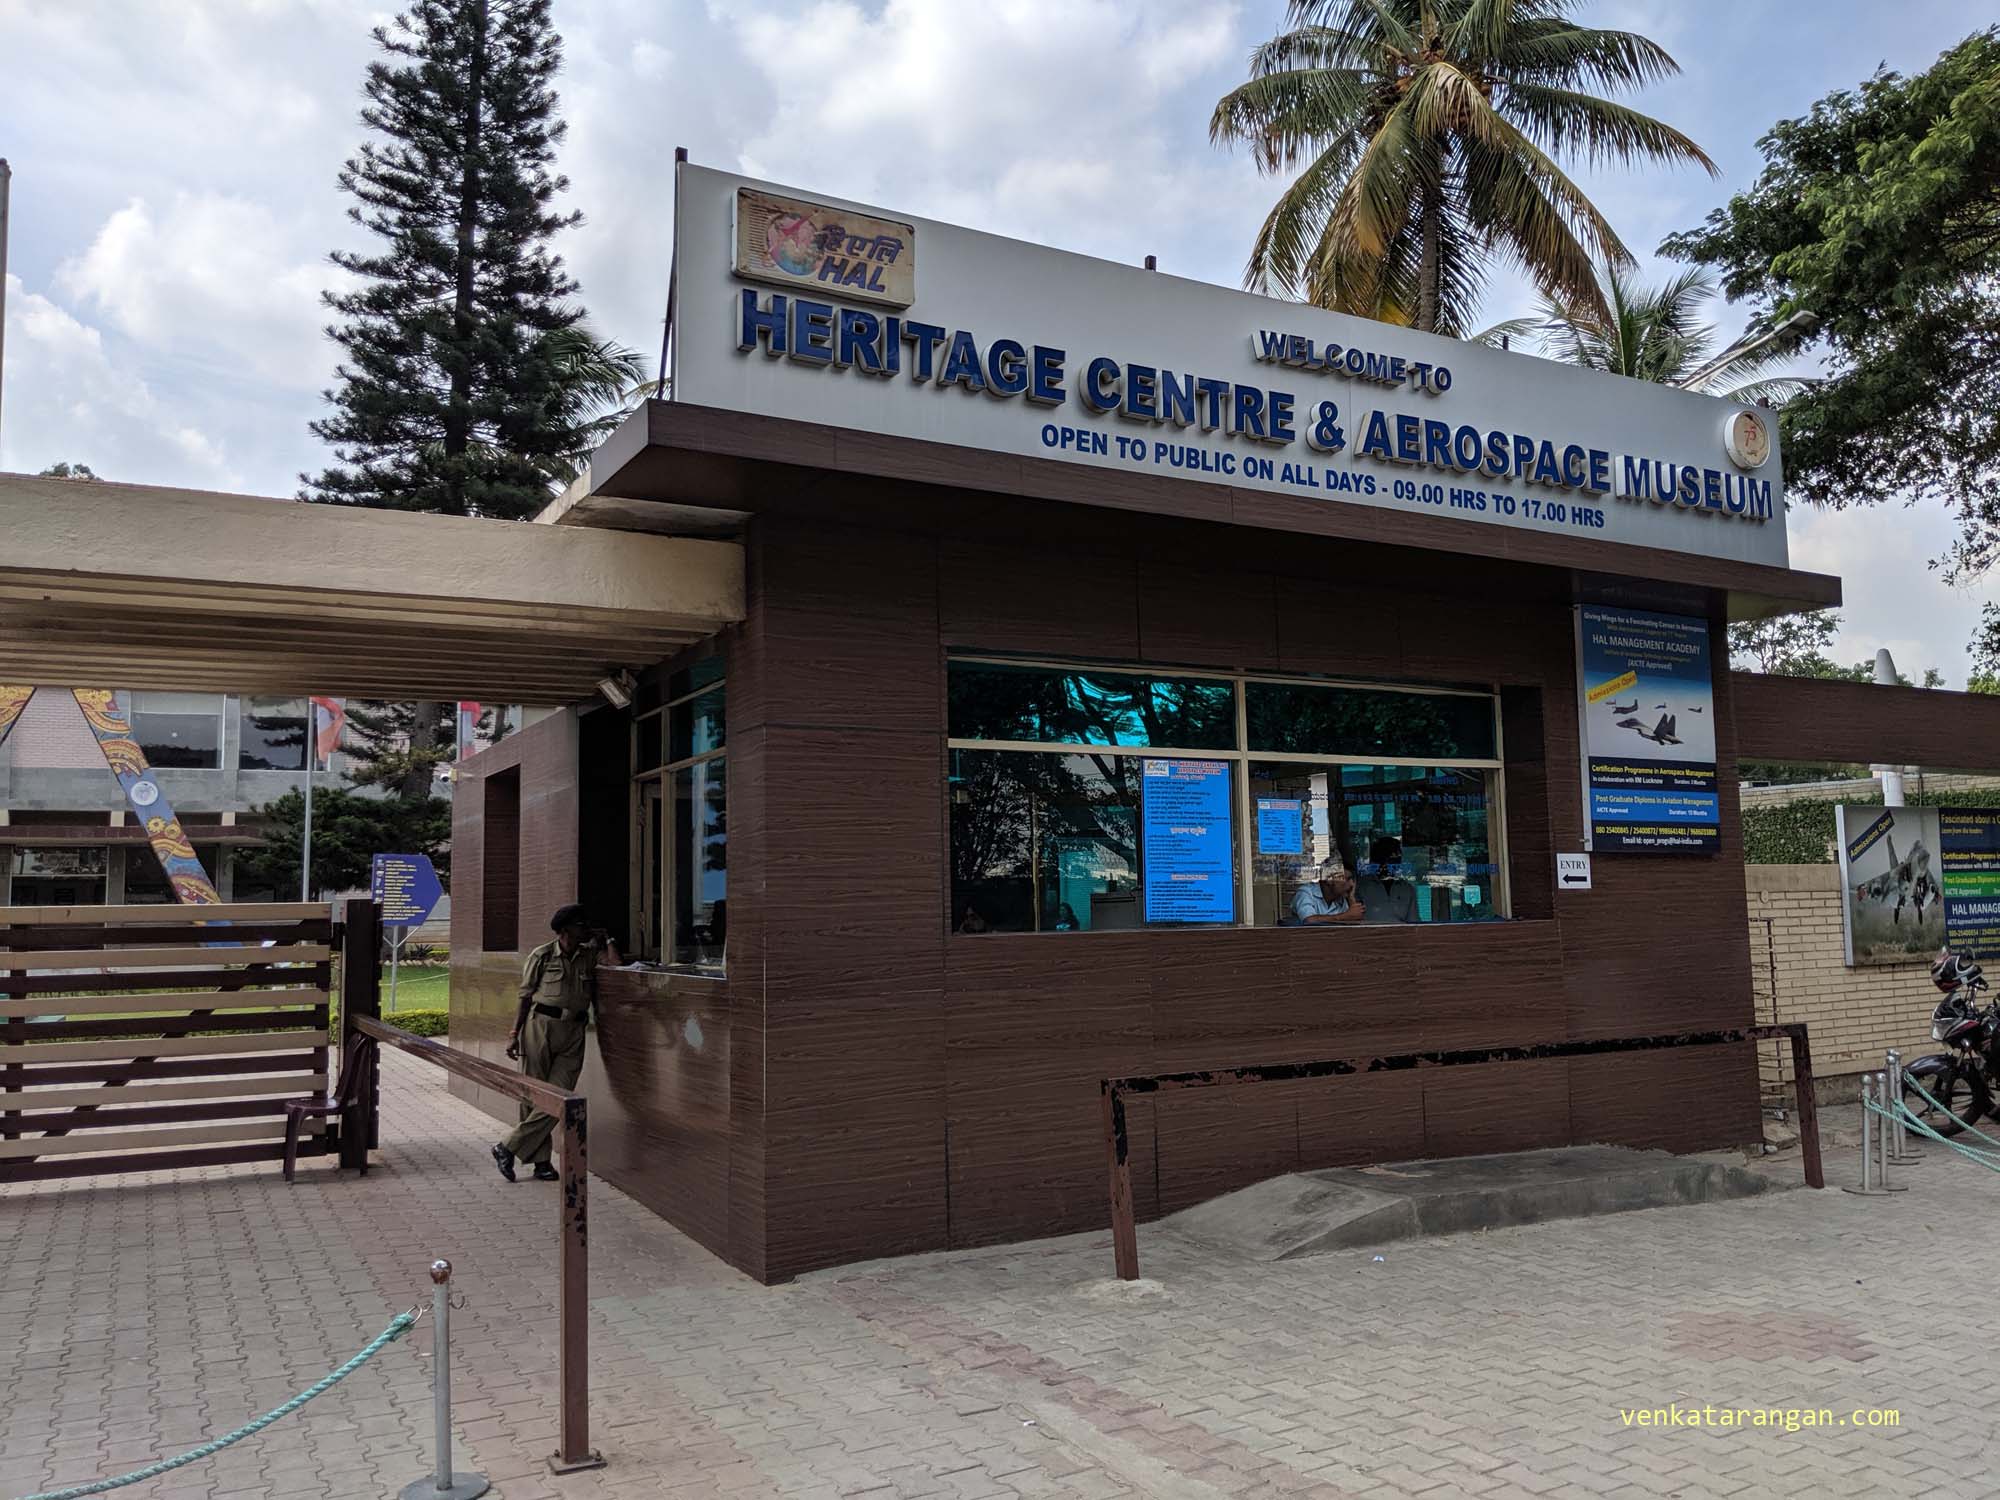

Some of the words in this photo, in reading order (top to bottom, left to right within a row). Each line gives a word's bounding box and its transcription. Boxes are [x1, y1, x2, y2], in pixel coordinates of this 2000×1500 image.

[818, 255, 886, 293] HAL
[1252, 329, 1408, 387] WELCOME
[1410, 361, 1453, 395] TO
[738, 288, 1067, 406] HERITAGE
[1082, 357, 1296, 444] CENTRE
[1308, 400, 1347, 453] &
[1355, 409, 1611, 494] AEROSPACE
[1616, 455, 1774, 521] MUSEUM
[1041, 424, 1108, 456] OPEN
[1115, 436, 1147, 461] TO
[1154, 443, 1237, 476] PUBLIC
[1242, 456, 1275, 481] ON
[1280, 463, 1320, 488] ALL
[1325, 469, 1377, 495] DAYS
[1393, 479, 1445, 505] 09.00
[1449, 487, 1487, 511] HRS
[1492, 493, 1517, 516] TO
[1521, 498, 1567, 523] 17.00
[1571, 505, 1605, 529] HRS
[1592, 634, 1608, 645] HAL
[1609, 636, 1665, 651] MANAGEMENT
[1666, 642, 1701, 655] ACADEMY
[1591, 764, 1624, 773] Certification
[1624, 765, 1654, 775] Programme
[1595, 794, 1608, 803] Post
[1609, 795, 1634, 803] Graduate
[1560, 860, 1586, 869] ENTRY
[1951, 903, 1968, 915] HAL
